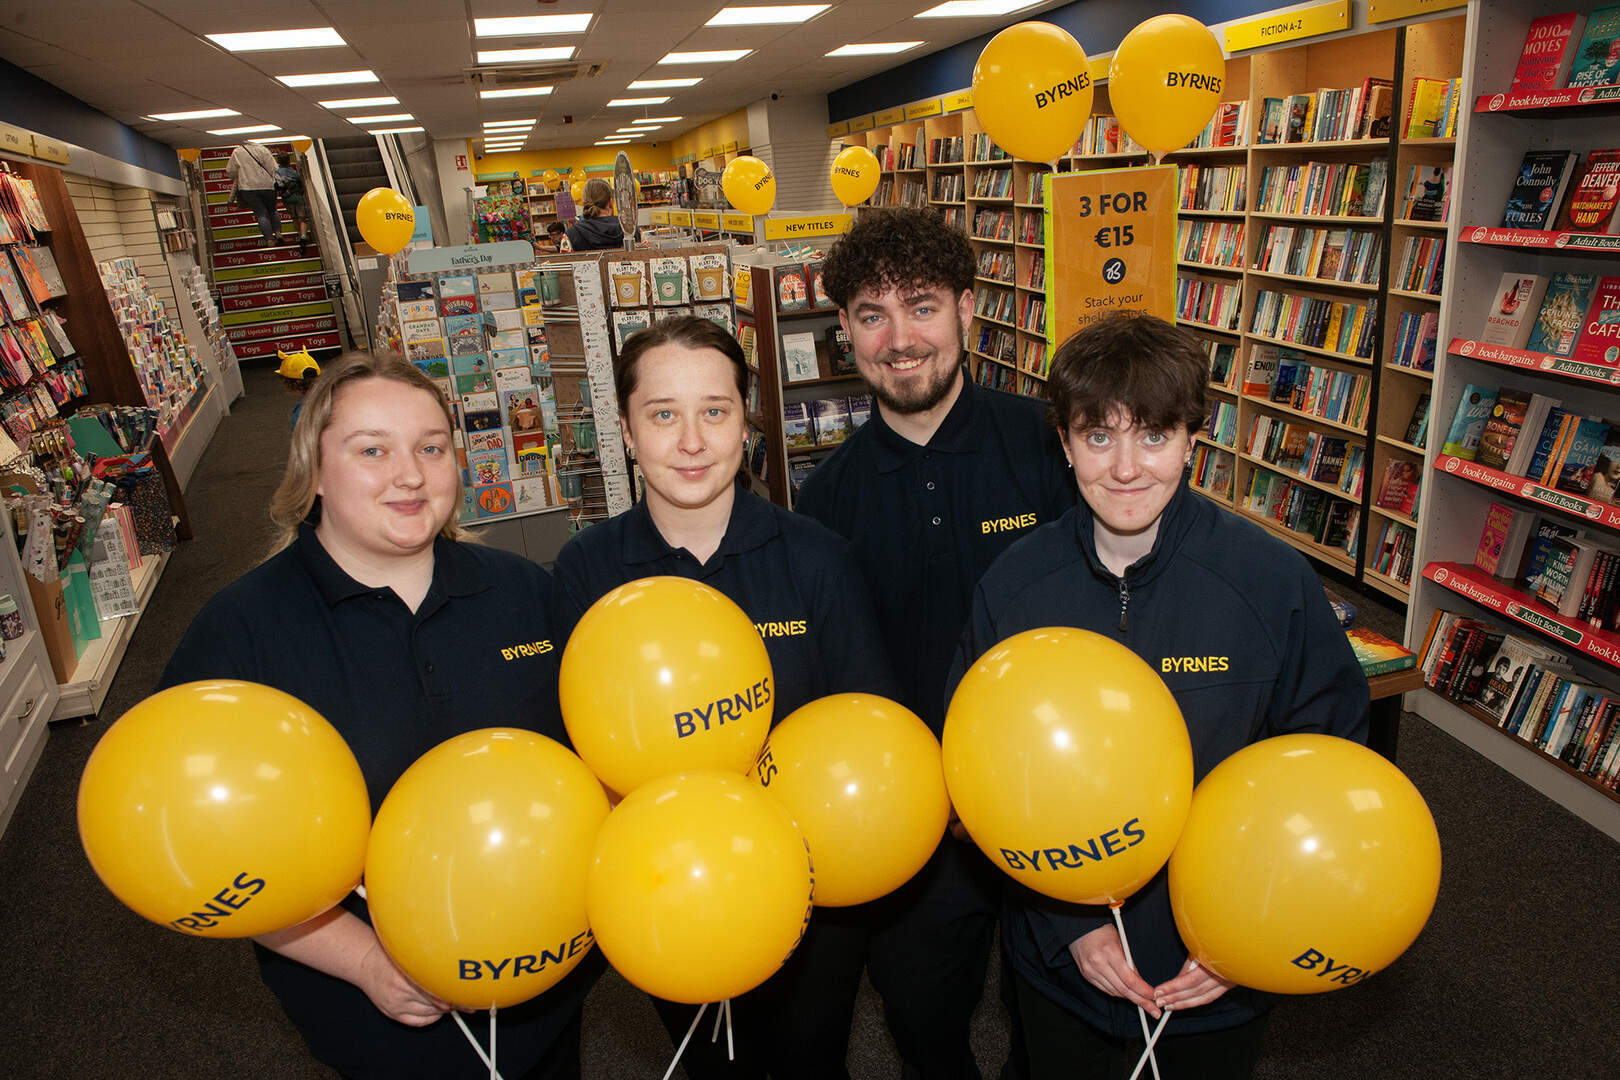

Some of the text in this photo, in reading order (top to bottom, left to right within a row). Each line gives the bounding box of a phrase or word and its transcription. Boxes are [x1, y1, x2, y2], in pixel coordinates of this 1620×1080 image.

[1260, 19, 1303, 37] FICTION A-Z
[1532, 24, 1562, 40] JOJO
[1523, 39, 1563, 55] MOYES
[1166, 71, 1222, 94] BYRNES
[1575, 69, 1608, 80] RISE OF
[1034, 71, 1090, 109] BYRNES
[1508, 93, 1571, 107] book bargains
[834, 166, 861, 178] BYRNES
[1528, 163, 1552, 177] John
[1591, 162, 1620, 173] JEFFERY
[1516, 176, 1556, 187] Connolly
[1581, 173, 1620, 188] DEAVER
[1079, 191, 1147, 218] 3 FOR
[385, 212, 413, 222] BYRNES
[1505, 212, 1544, 223] FURIES
[1575, 212, 1600, 224] HAND
[785, 220, 835, 232] NEW TITLES
[1094, 225, 1135, 248] €15
[1490, 231, 1550, 246] book bargains
[1573, 237, 1599, 247] Adult
[451, 254, 493, 265] Father's Day
[234, 299, 253, 307] Toys
[1084, 293, 1144, 309] Stack your
[1603, 294, 1620, 310] TH
[1540, 308, 1577, 320] GENUINE
[272, 325, 289, 333] LEGO
[316, 320, 332, 328] LEGO
[1551, 319, 1581, 329] FRAUD
[241, 337, 327, 354] Toys Toys Toys
[1478, 346, 1535, 366] book bargains
[1558, 362, 1607, 378] Adult Books
[1502, 410, 1516, 421] THE
[1486, 421, 1508, 434] BONE
[487, 438, 504, 450] DAD
[1322, 455, 1344, 467] HAMNE
[1576, 453, 1598, 467] LIES
[1461, 465, 1517, 491] book bargains
[1537, 490, 1583, 512] Adult Books
[981, 512, 1037, 534] BYRNES
[1557, 551, 1571, 563] THE
[1545, 567, 1570, 585] WORTH
[1449, 577, 1502, 608] book bargains
[1541, 575, 1567, 594] KILLING
[754, 620, 807, 638] YRNES
[1521, 611, 1565, 637] Adult Books
[501, 639, 554, 661] BYRNES
[1587, 639, 1611, 659] book
[1161, 655, 1229, 674] BYRNES
[674, 677, 771, 739] BYRNES
[1000, 817, 1145, 872] BYRNES
[1291, 947, 1371, 986] BYRN
